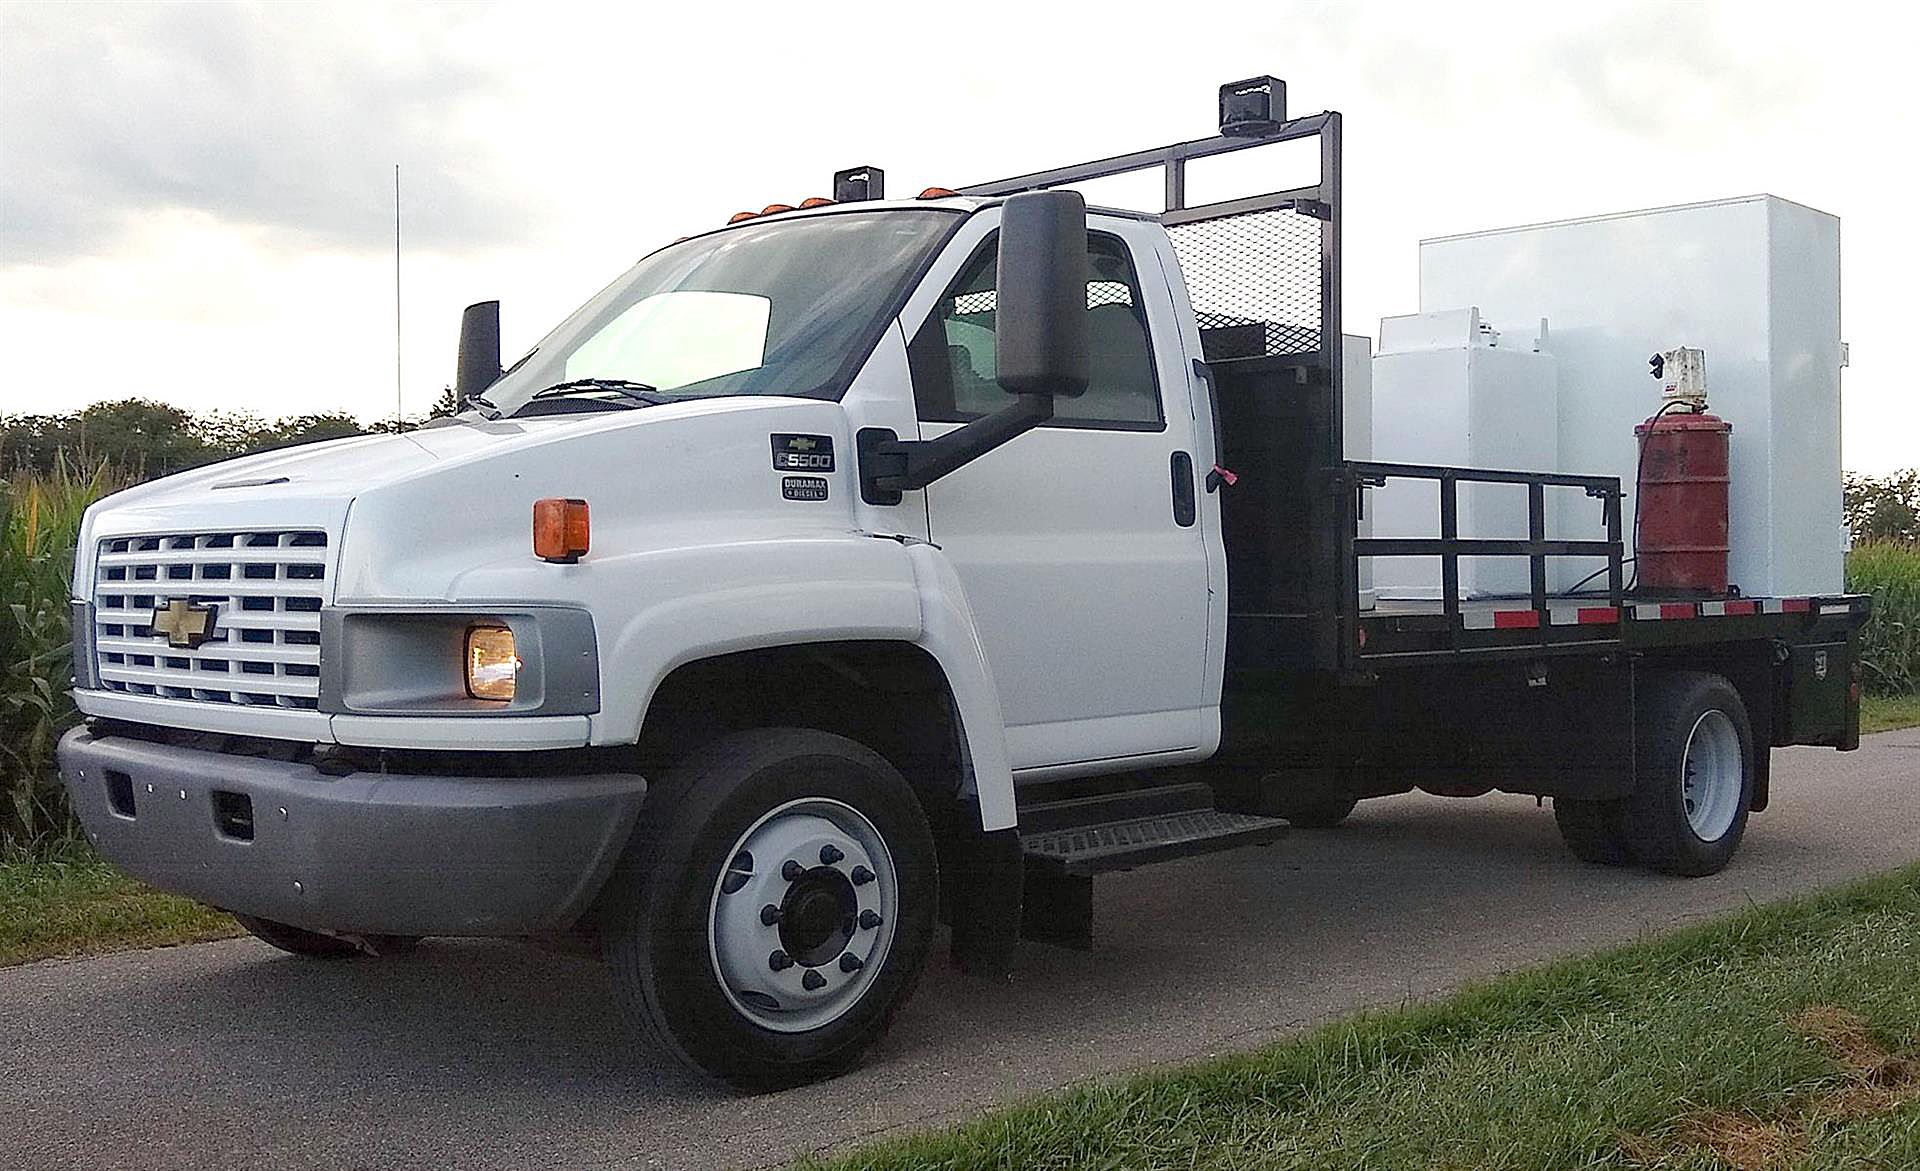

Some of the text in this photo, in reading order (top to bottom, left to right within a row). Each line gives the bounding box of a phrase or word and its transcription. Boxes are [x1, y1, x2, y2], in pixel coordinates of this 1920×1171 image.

[777, 452, 832, 468] C5500
[785, 479, 826, 489] DURAMAX
[794, 490, 818, 498] DIESEL
